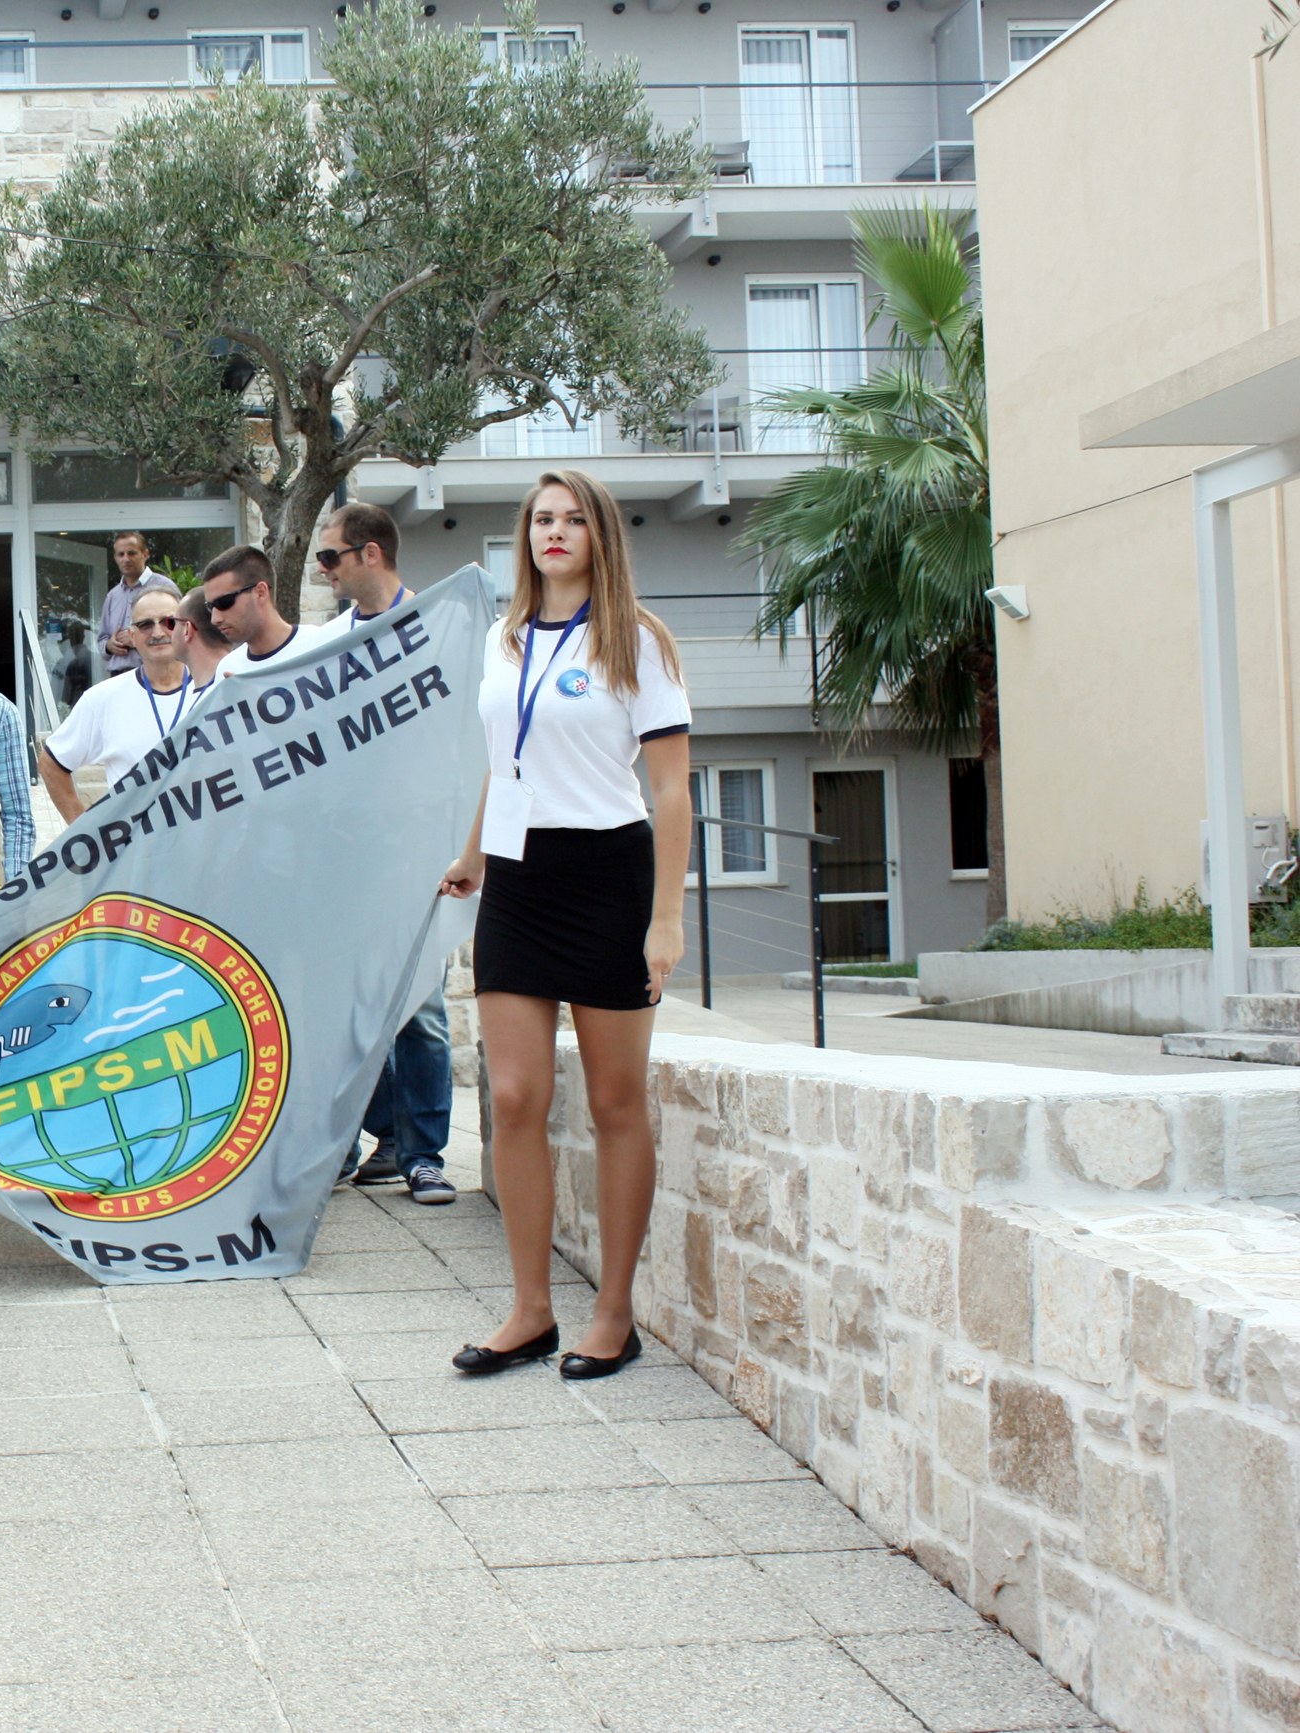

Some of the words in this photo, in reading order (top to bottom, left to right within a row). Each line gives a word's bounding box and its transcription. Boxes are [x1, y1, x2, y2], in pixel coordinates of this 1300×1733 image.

[253, 731, 328, 792] EN
[337, 664, 452, 752] MER
[129, 908, 161, 933] DE
[178, 927, 209, 953] LA
[219, 955, 272, 1026] PECHE
[219, 1045, 277, 1165] SPORTIVE
[98, 1189, 173, 1214] CIPS
